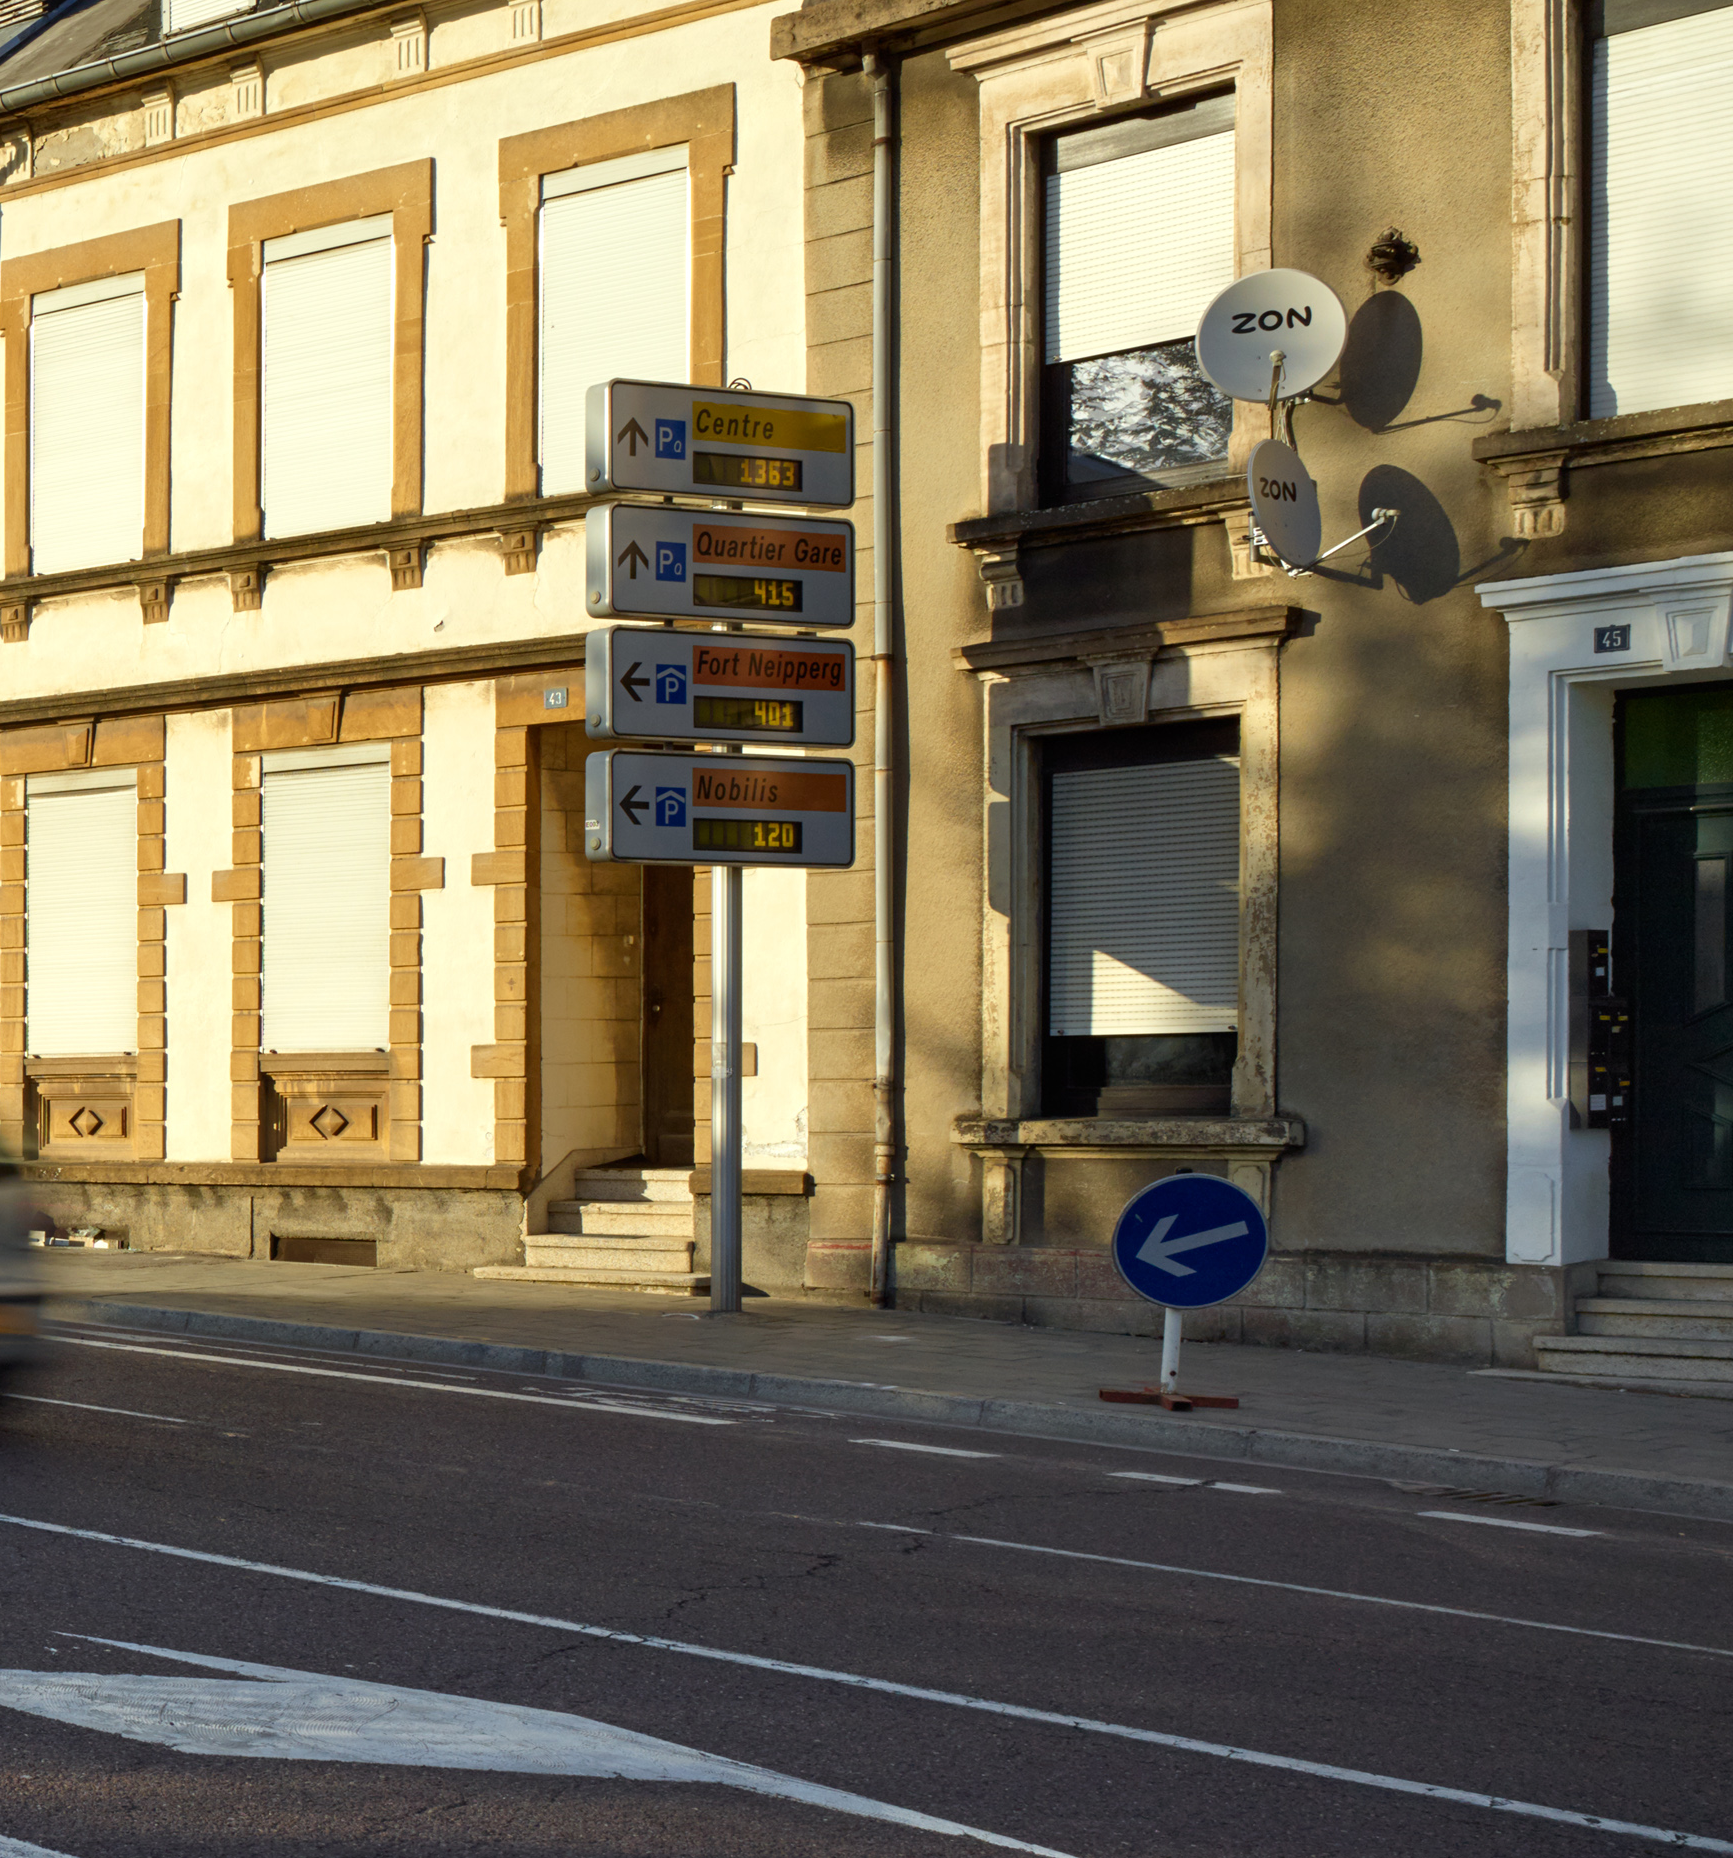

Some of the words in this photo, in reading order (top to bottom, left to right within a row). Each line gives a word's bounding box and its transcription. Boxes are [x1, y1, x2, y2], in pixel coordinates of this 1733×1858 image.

[1231, 305, 1312, 334] ZON
[696, 408, 774, 439] Centre
[740, 458, 794, 486] 1363
[1259, 477, 1297, 502] ZON
[696, 531, 785, 561] Quartier
[794, 538, 842, 566] Gare
[754, 579, 794, 606] 415
[1602, 630, 1621, 647] 45
[696, 650, 740, 676] Fort
[748, 652, 842, 687] Neipperg
[549, 691, 562, 705] 43
[754, 700, 794, 727] 401
[696, 775, 778, 803] Nobilis
[754, 822, 794, 848] 120
